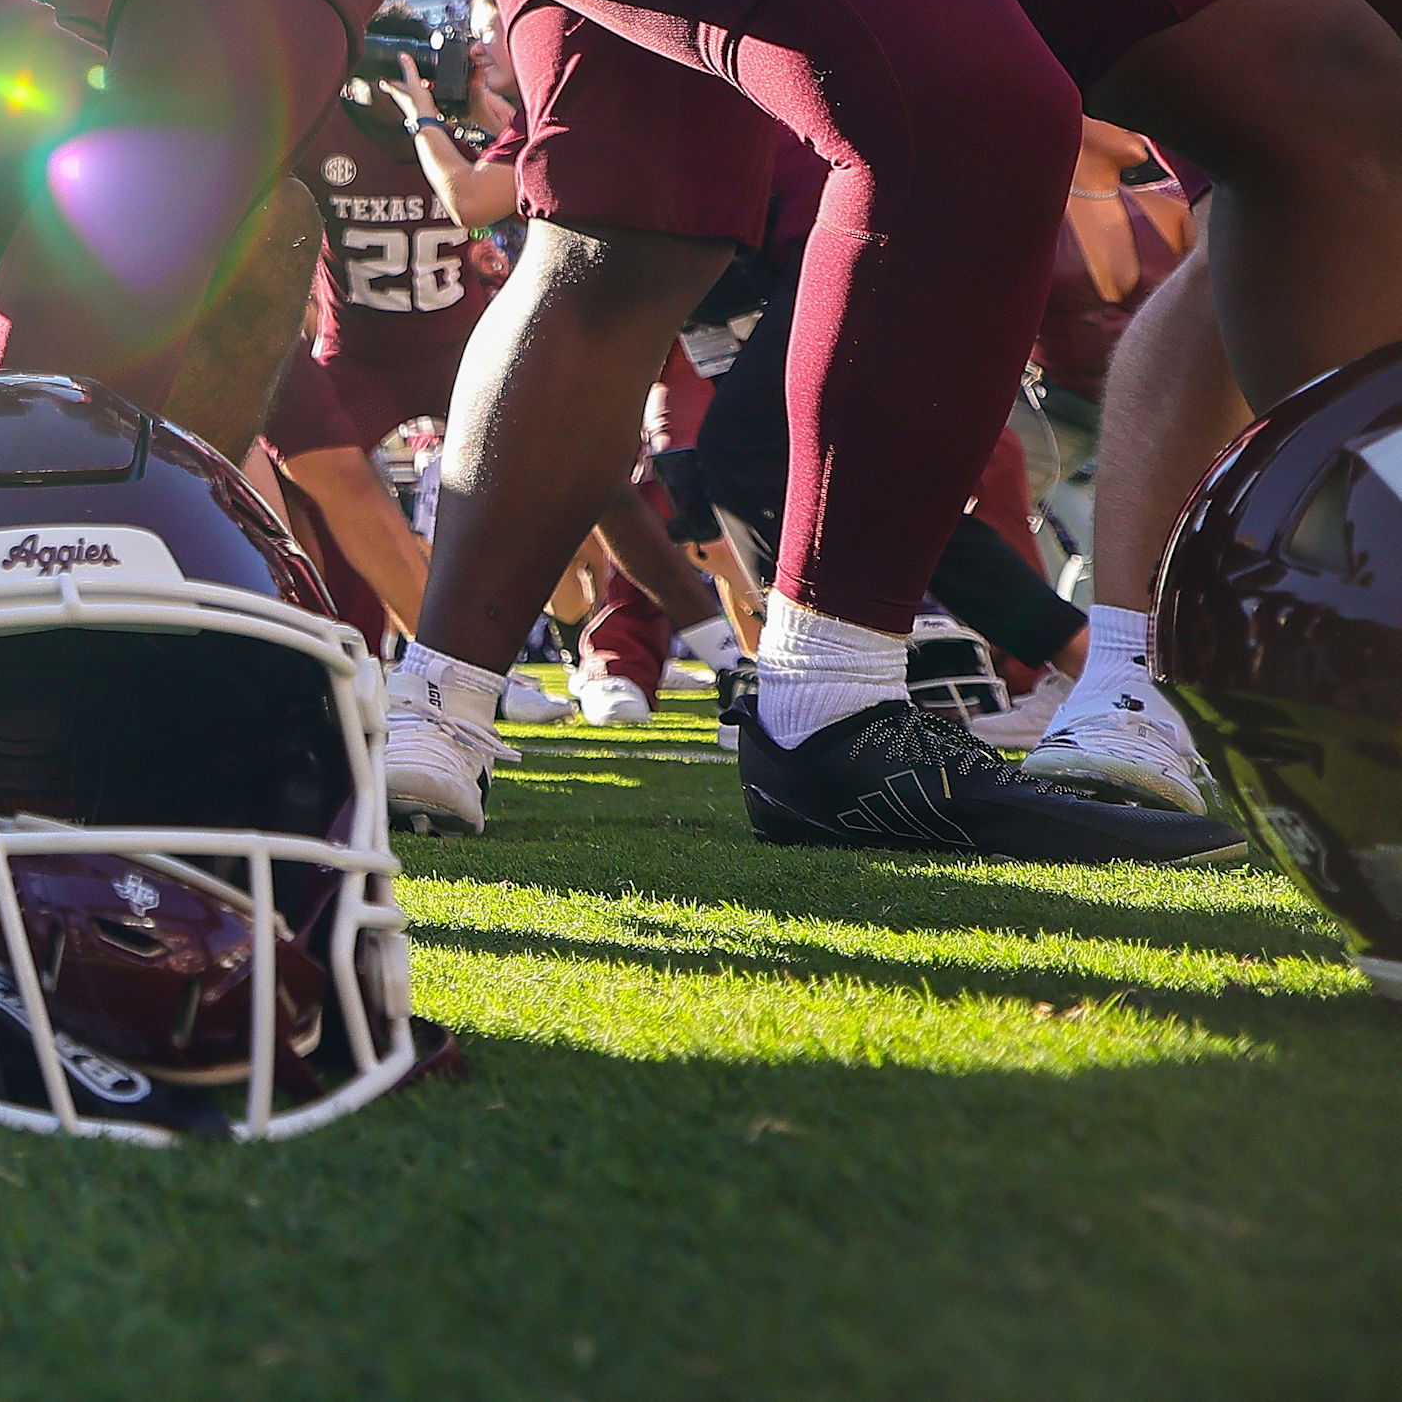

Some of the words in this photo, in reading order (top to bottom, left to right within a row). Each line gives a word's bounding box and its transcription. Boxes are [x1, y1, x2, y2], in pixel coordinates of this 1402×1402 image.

[325, 155, 355, 184] SEC
[330, 195, 425, 223] TEXAS
[342, 226, 470, 313] 26
[2, 533, 120, 577] Aggies
